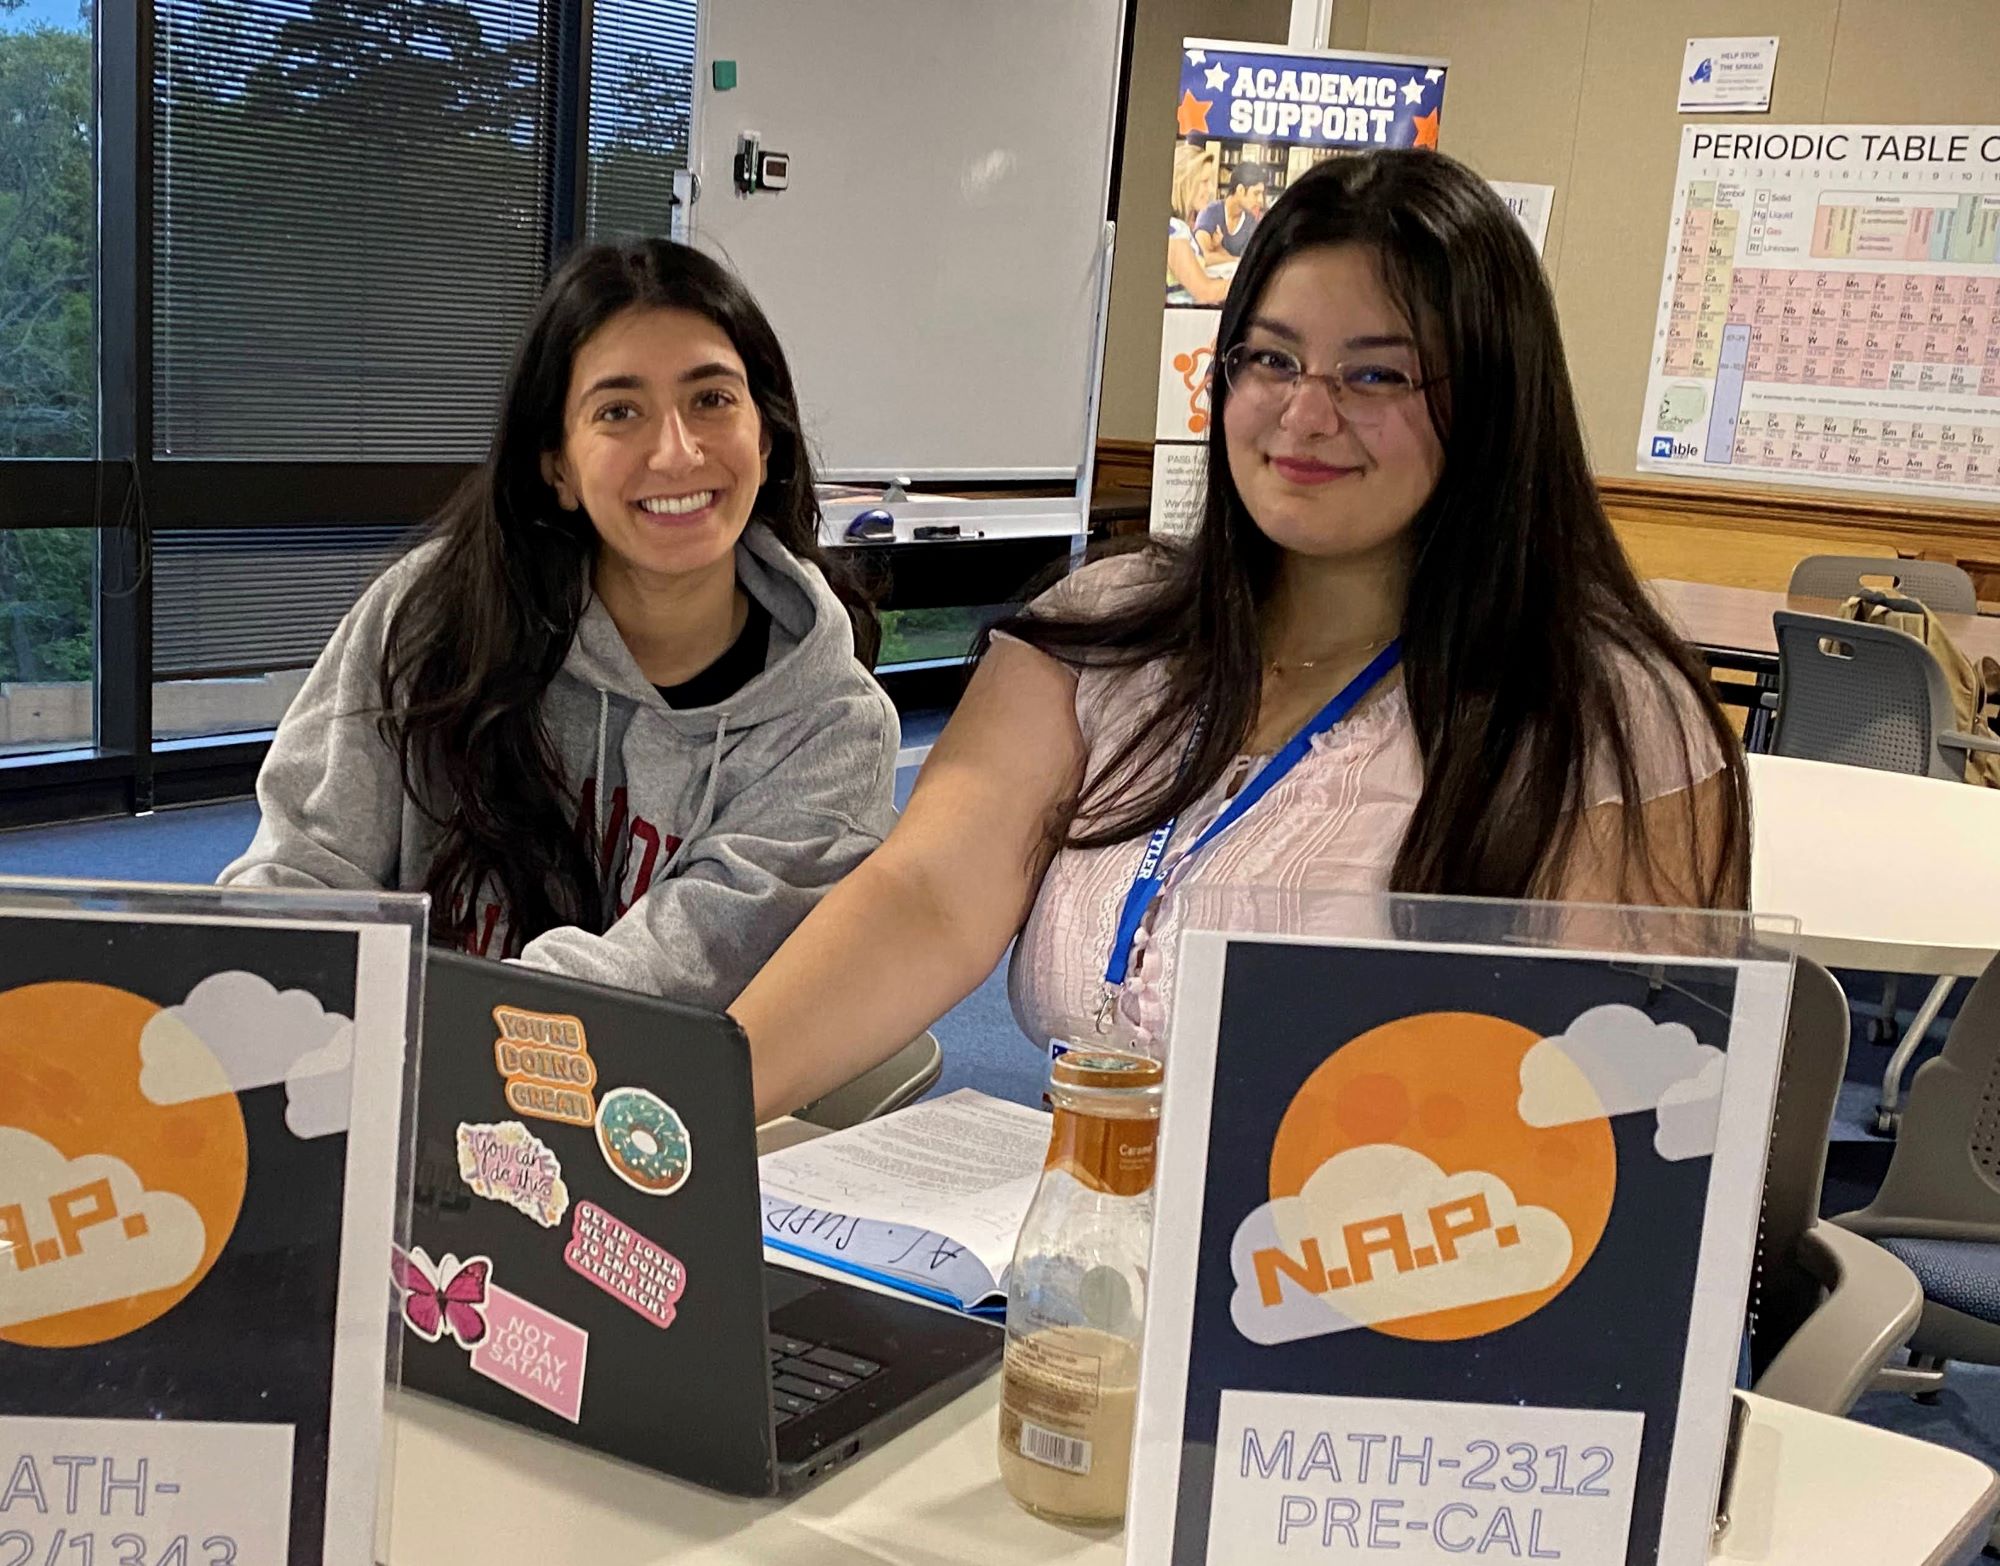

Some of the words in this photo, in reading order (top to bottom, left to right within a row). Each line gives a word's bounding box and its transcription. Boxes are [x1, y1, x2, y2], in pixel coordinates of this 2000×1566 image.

[1721, 52, 1739, 60] HELP
[1231, 66, 1397, 107] ACADEMIC
[1230, 99, 1394, 142] SUPPORT
[1693, 134, 1849, 161] PERIODIC
[1861, 135, 1969, 162] TABLE
[1136, 827, 1171, 881] TYLER
[501, 1044, 591, 1084] DOING
[580, 1220, 624, 1258] WE'RE
[629, 1252, 677, 1292] GOING
[581, 1205, 609, 1230] GET
[612, 1225, 631, 1245] IN
[634, 1240, 681, 1280] LOSER
[582, 1237, 599, 1257] TO
[603, 1252, 634, 1280] END
[638, 1274, 667, 1303] THE
[1252, 1191, 1520, 1307] N.A.P.
[571, 1247, 669, 1320] PATRIARCHY
[495, 1324, 568, 1375] TODAY
[507, 1315, 557, 1350] NOT
[488, 1342, 565, 1397] SATAN.
[0, 1455, 181, 1517] ATH-
[1240, 1427, 1615, 1497] MATH-2312
[1277, 1494, 1561, 1559] PRE-CAL
